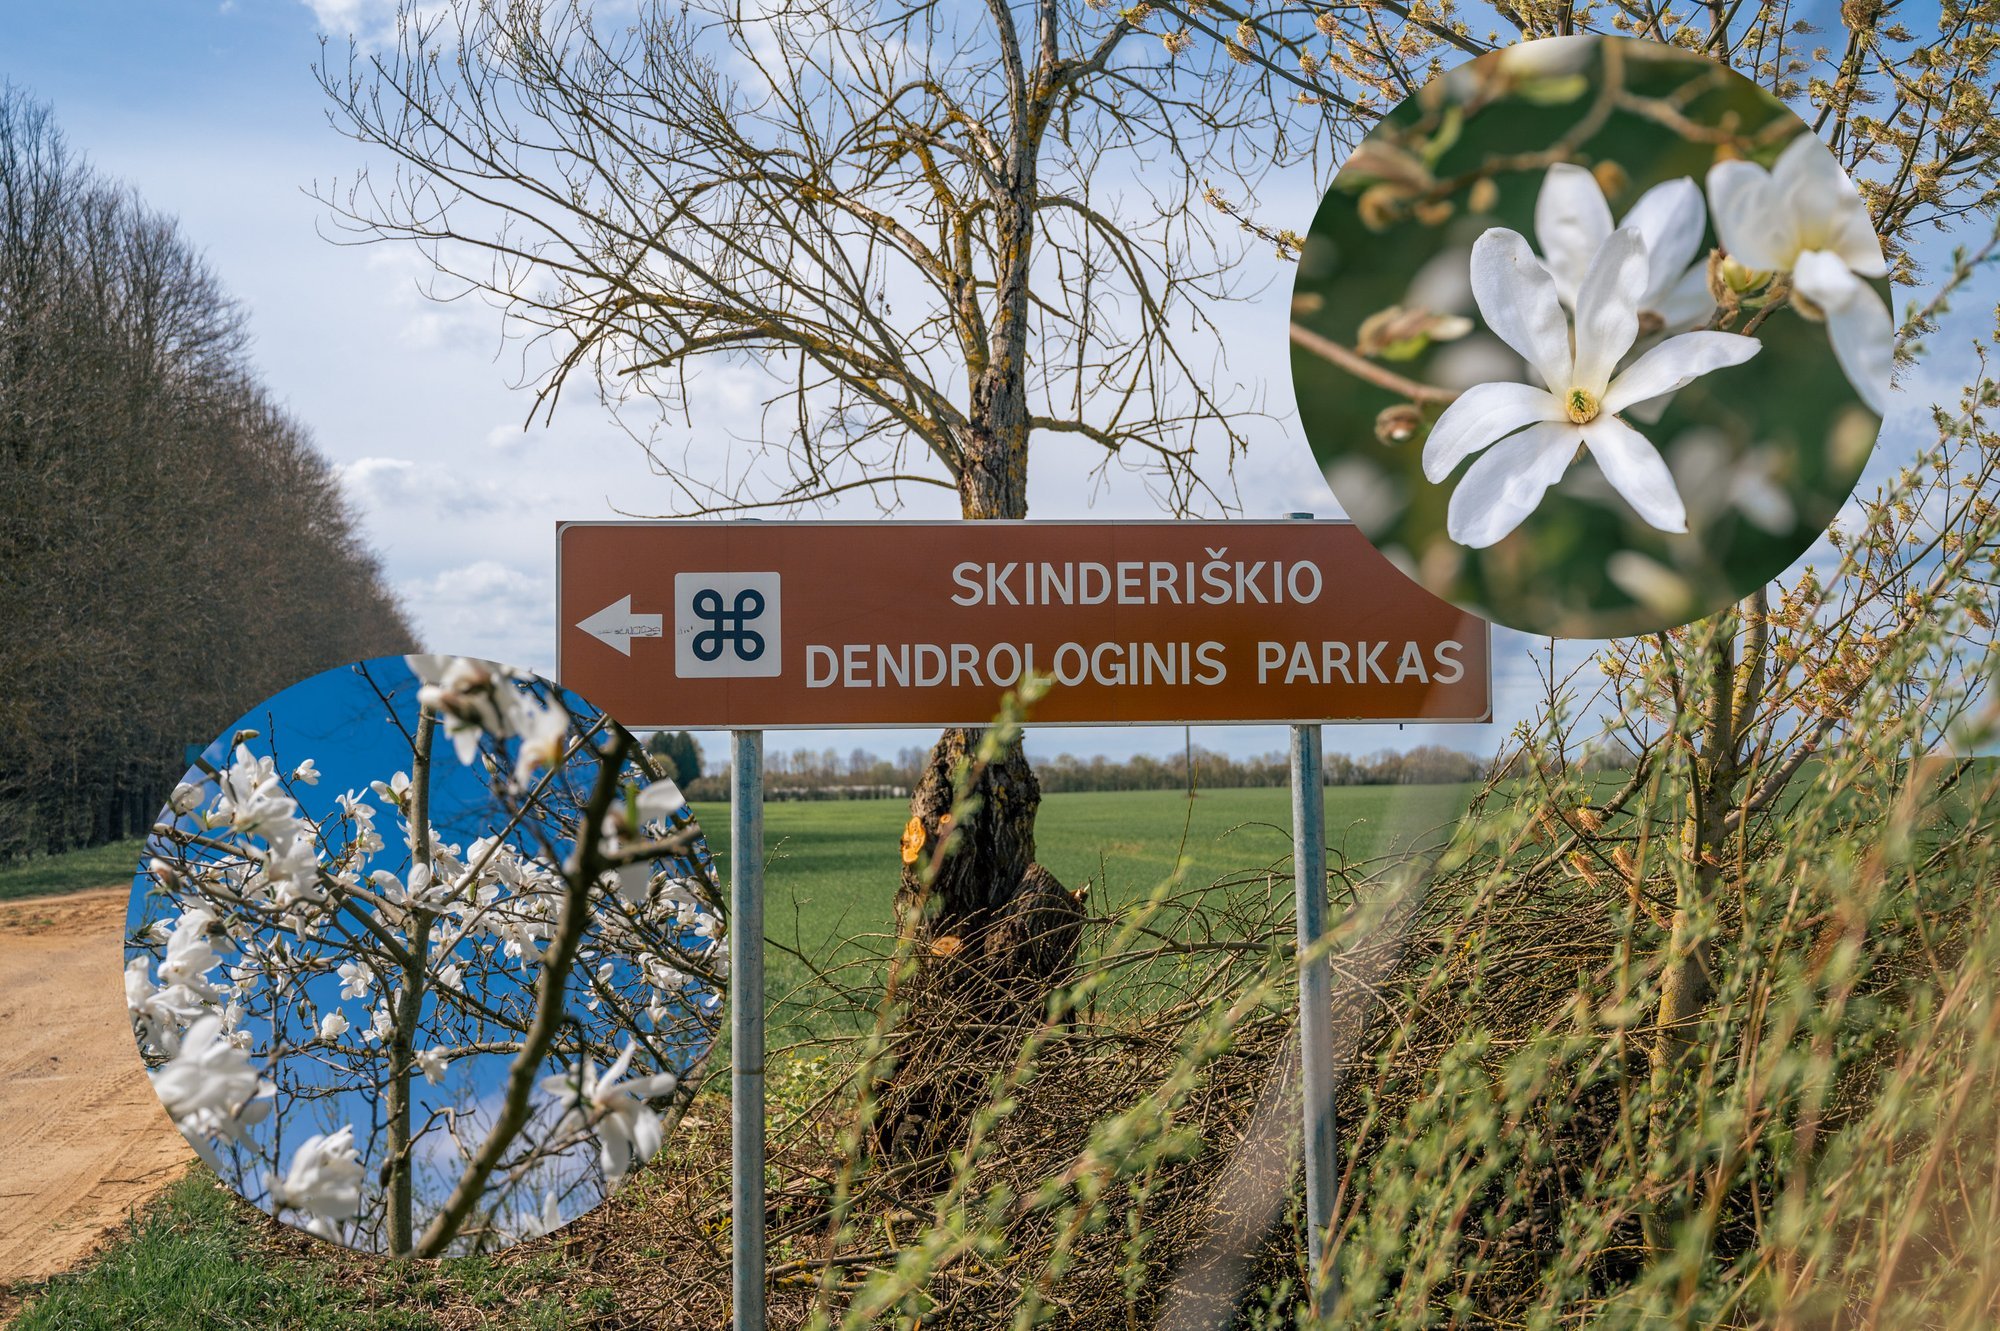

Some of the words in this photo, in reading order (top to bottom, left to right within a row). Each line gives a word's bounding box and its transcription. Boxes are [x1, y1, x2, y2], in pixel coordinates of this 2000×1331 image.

[951, 547, 1323, 606] SKINDERIŠKIO
[805, 640, 1227, 688] DENDROLOGINIS
[1257, 640, 1465, 685] PARKAS
